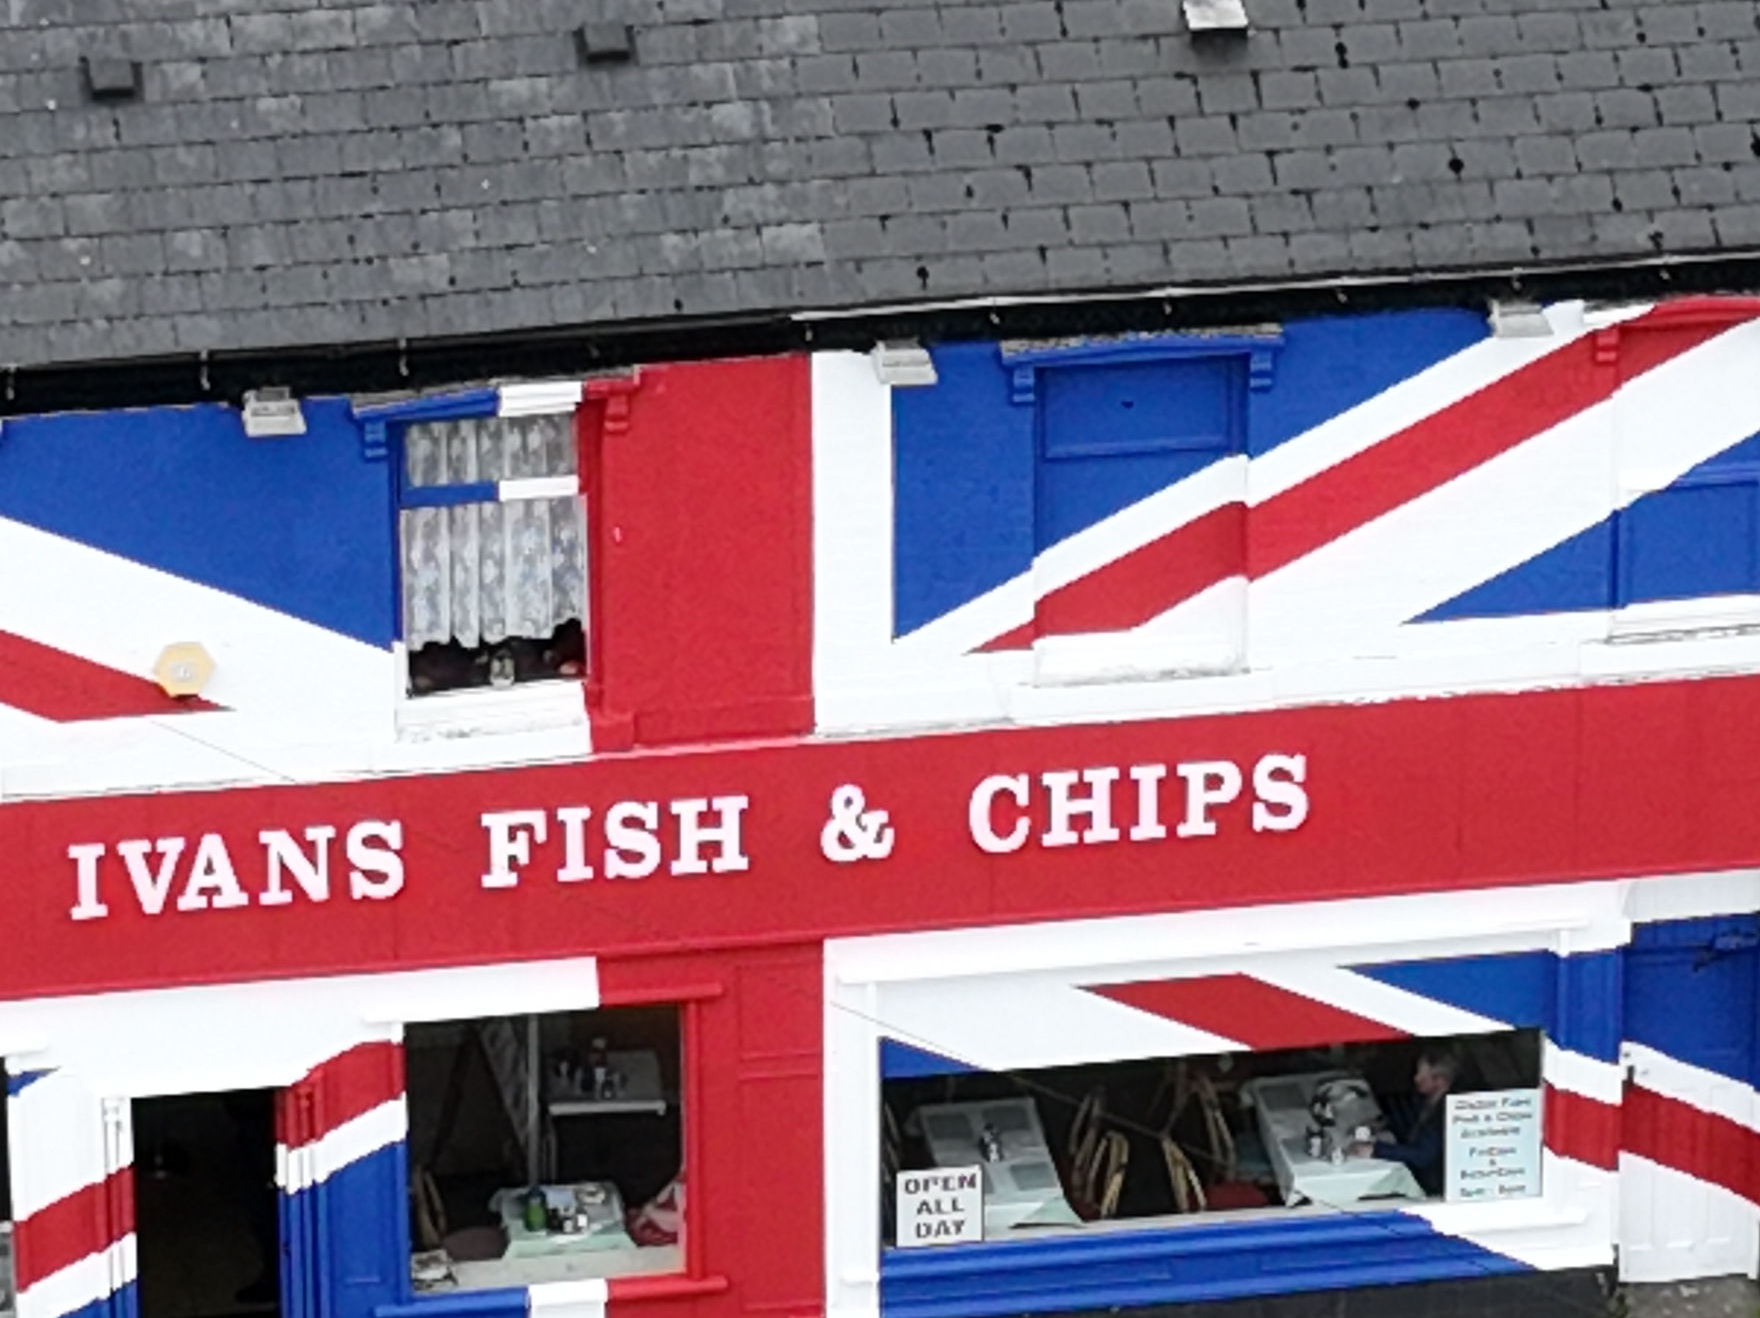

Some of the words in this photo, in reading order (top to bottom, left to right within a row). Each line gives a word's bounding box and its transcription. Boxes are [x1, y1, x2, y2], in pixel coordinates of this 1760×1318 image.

[68, 819, 405, 921] IVANS
[480, 794, 750, 889] FISH
[820, 783, 895, 862] &
[968, 753, 1309, 854] CHIPS
[904, 1173, 977, 1195] OPEN
[916, 1197, 965, 1216] ALL
[916, 1220, 966, 1239] DAY
